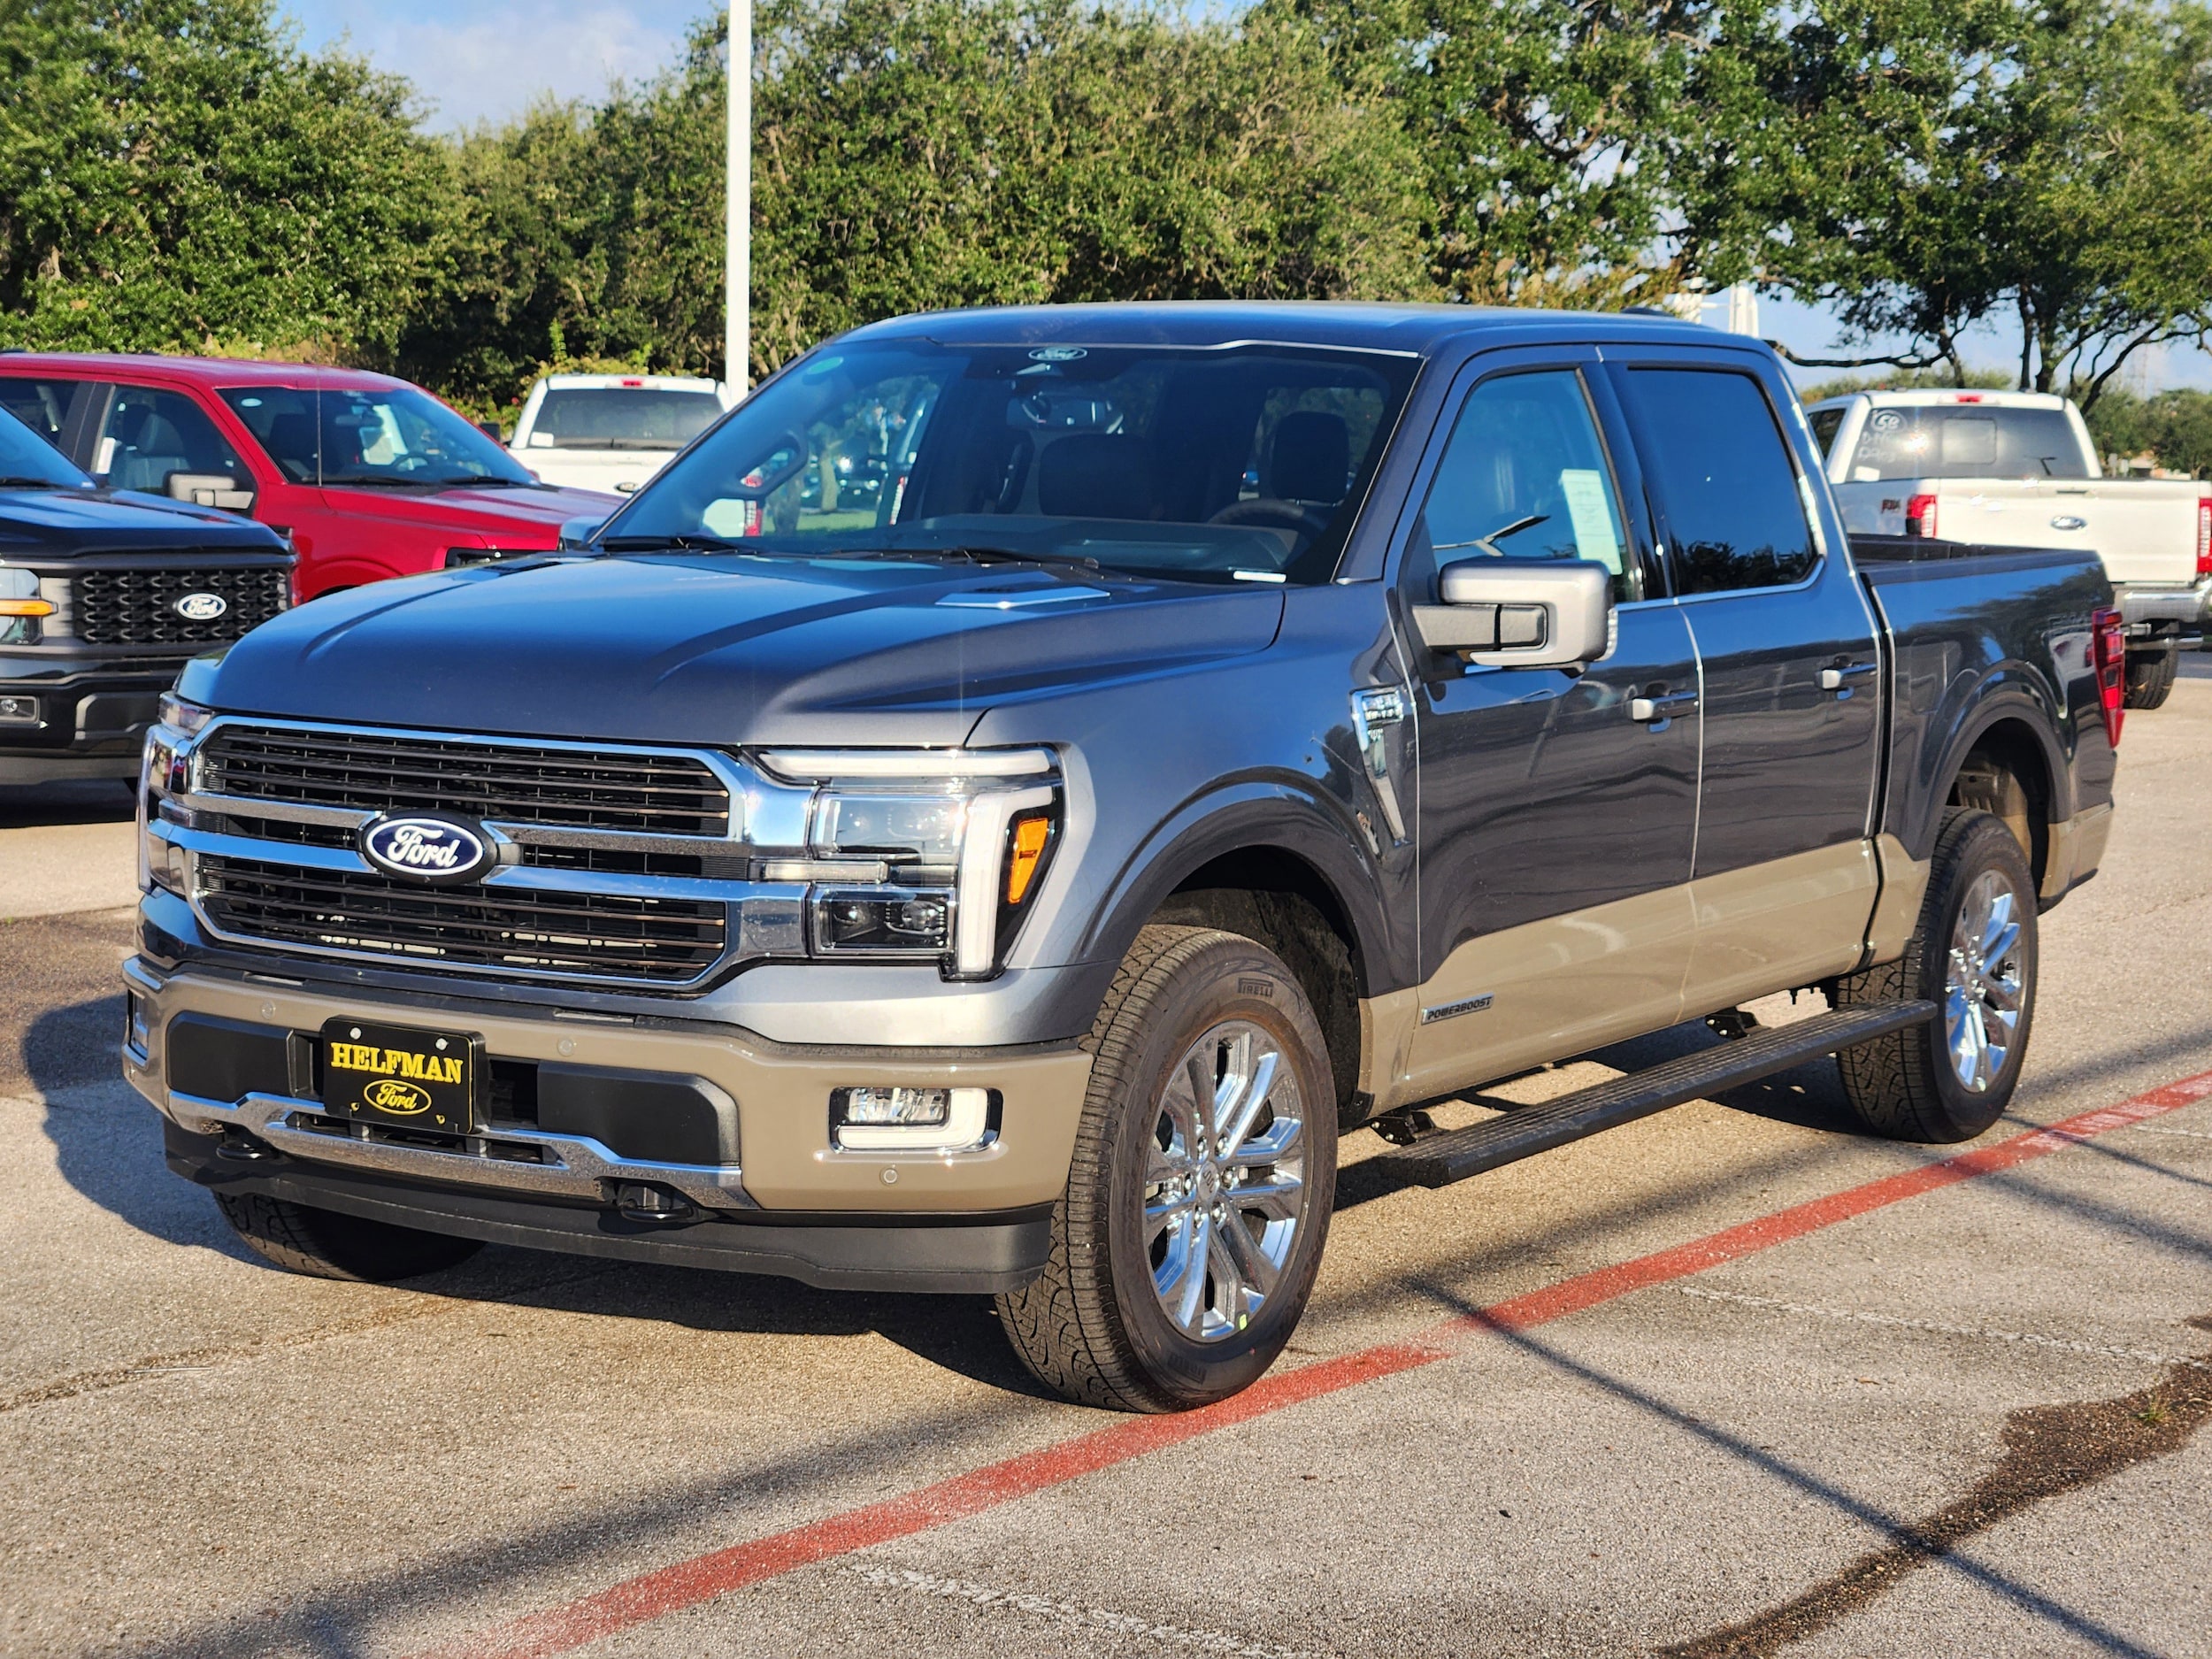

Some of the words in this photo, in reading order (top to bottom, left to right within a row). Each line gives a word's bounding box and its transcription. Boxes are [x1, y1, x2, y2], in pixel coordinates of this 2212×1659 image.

[186, 596, 219, 615] Ford
[387, 825, 461, 868] Ford
[1238, 977, 1274, 998] PIRELLI
[1427, 995, 1493, 1020] POWERBOOST
[330, 1041, 464, 1085] HELFMAN
[375, 1082, 419, 1110] Ford
